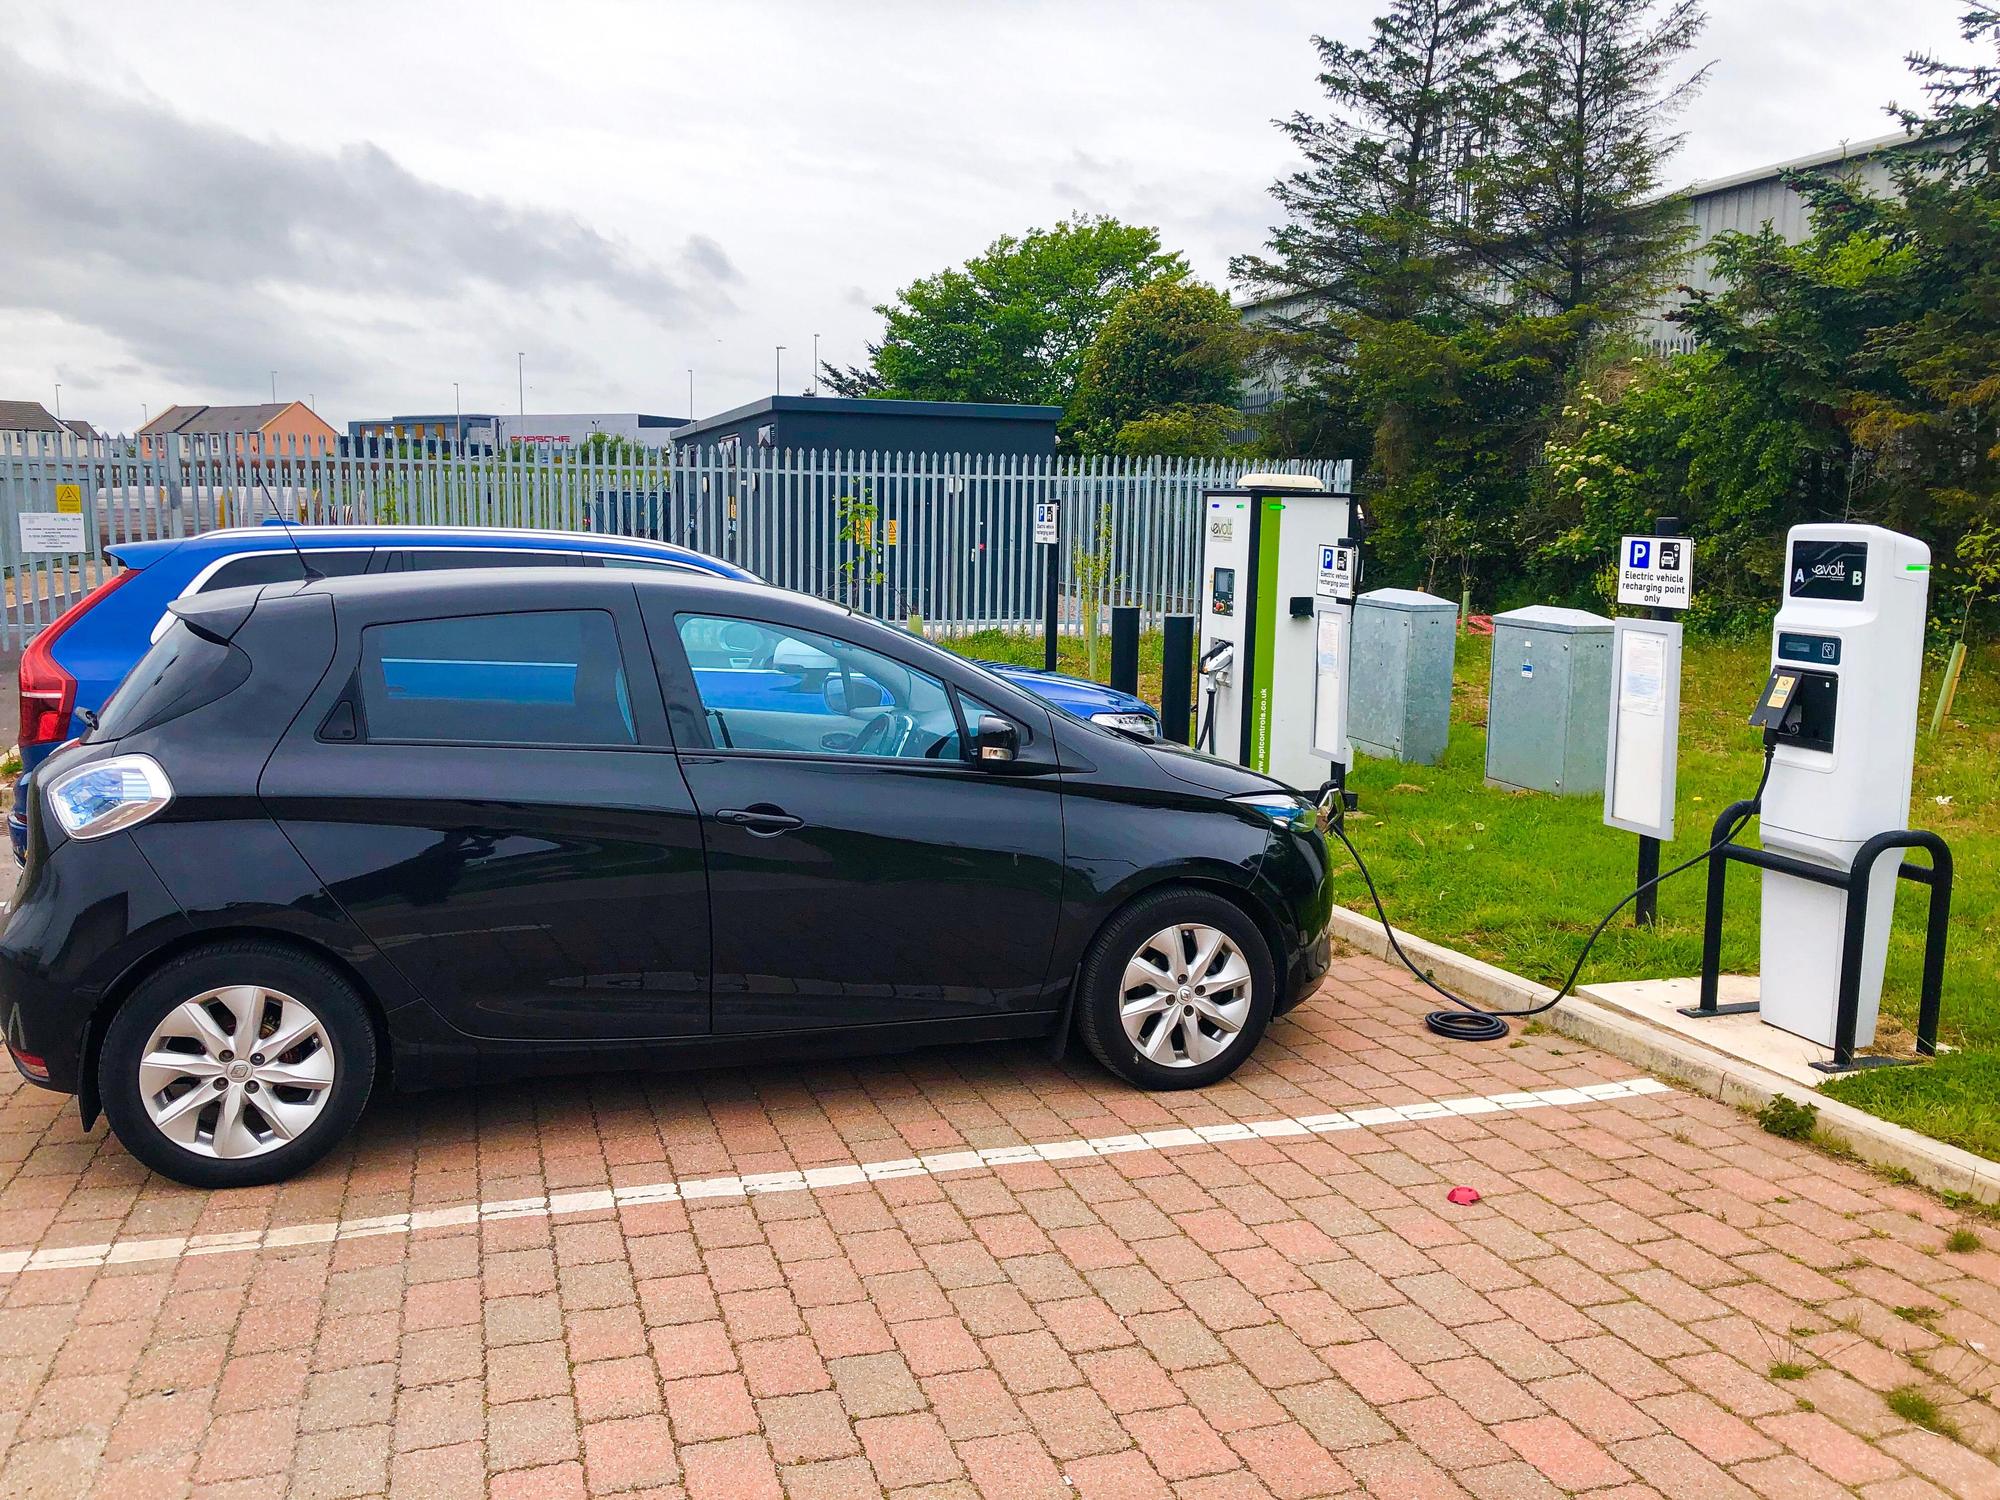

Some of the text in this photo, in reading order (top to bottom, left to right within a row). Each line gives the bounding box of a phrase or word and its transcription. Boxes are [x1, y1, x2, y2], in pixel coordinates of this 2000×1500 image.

[1325, 551, 1331, 566] P
[1634, 544, 1646, 564] P
[1795, 568, 1804, 582] A
[1812, 561, 1845, 575] evolt
[1625, 571, 1683, 582] Electric vehicle
[1852, 571, 1862, 585] B
[1622, 582, 1685, 594] recharging point
[1644, 594, 1660, 604] only
